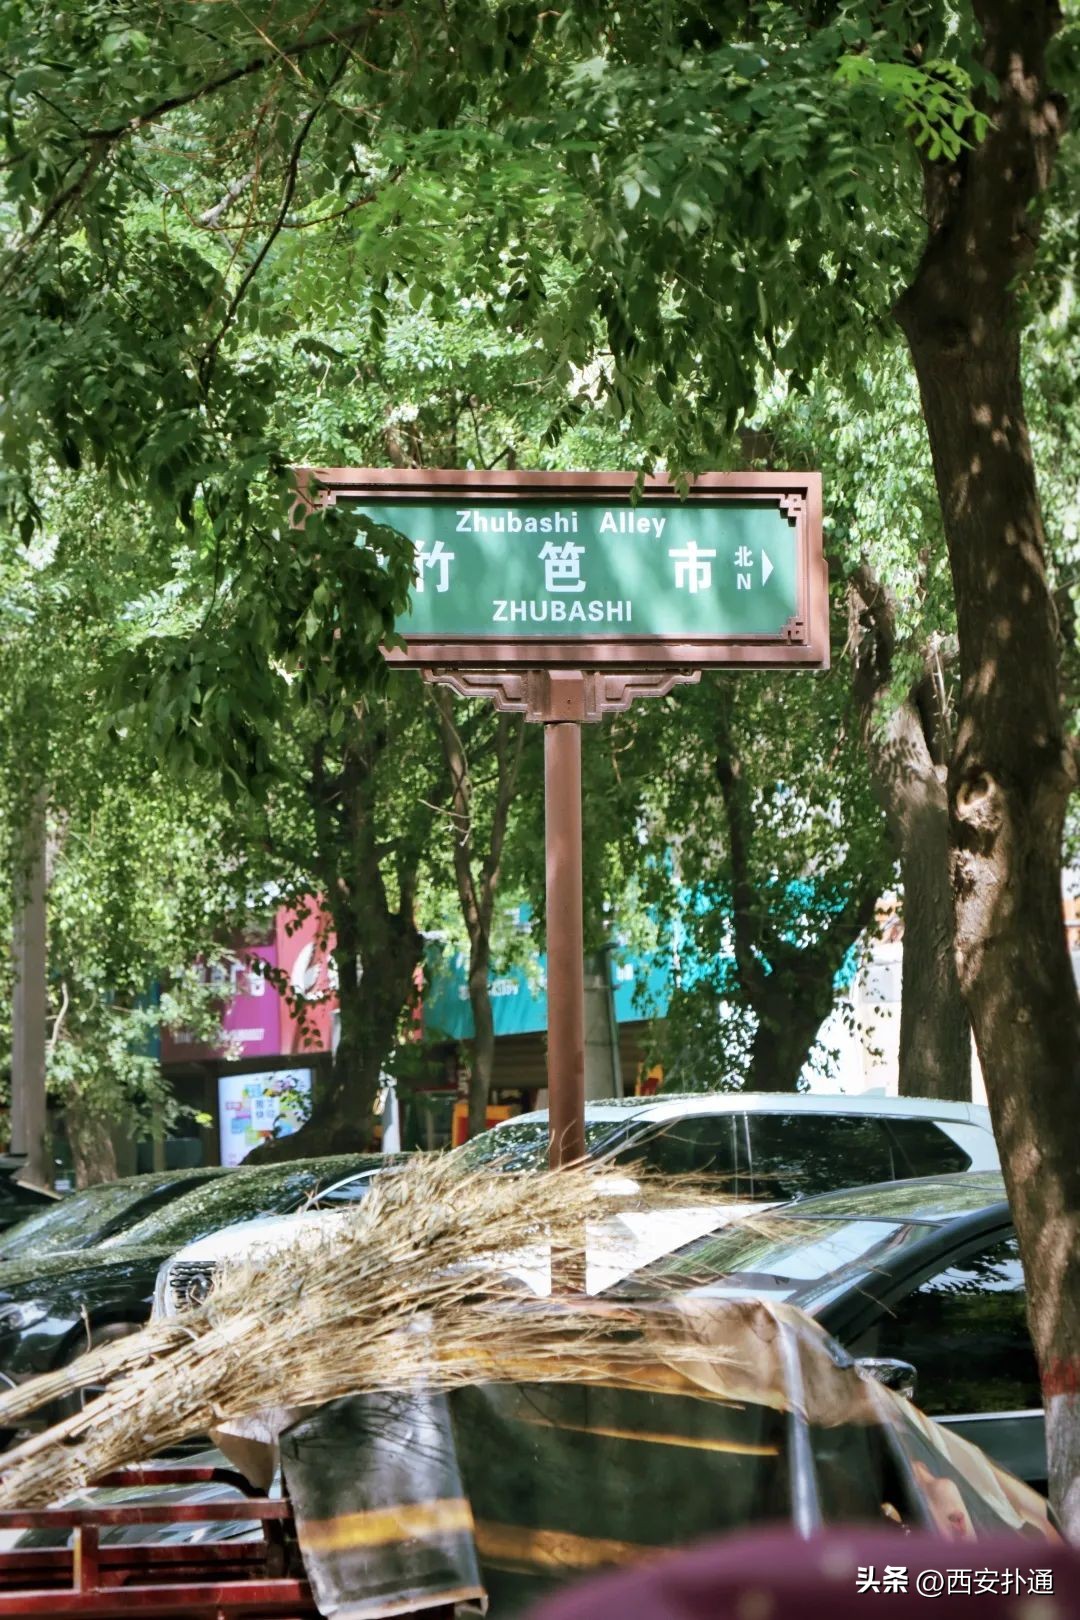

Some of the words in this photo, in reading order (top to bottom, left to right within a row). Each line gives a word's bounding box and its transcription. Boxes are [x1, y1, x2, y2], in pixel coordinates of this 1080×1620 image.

[455, 510, 579, 533] Zhubashi
[599, 511, 666, 538] Alley
[413, 540, 716, 593] 竹笆市
[733, 545, 754, 567] 北
[737, 573, 752, 590] N
[492, 600, 633, 622] ZHUBASHI
